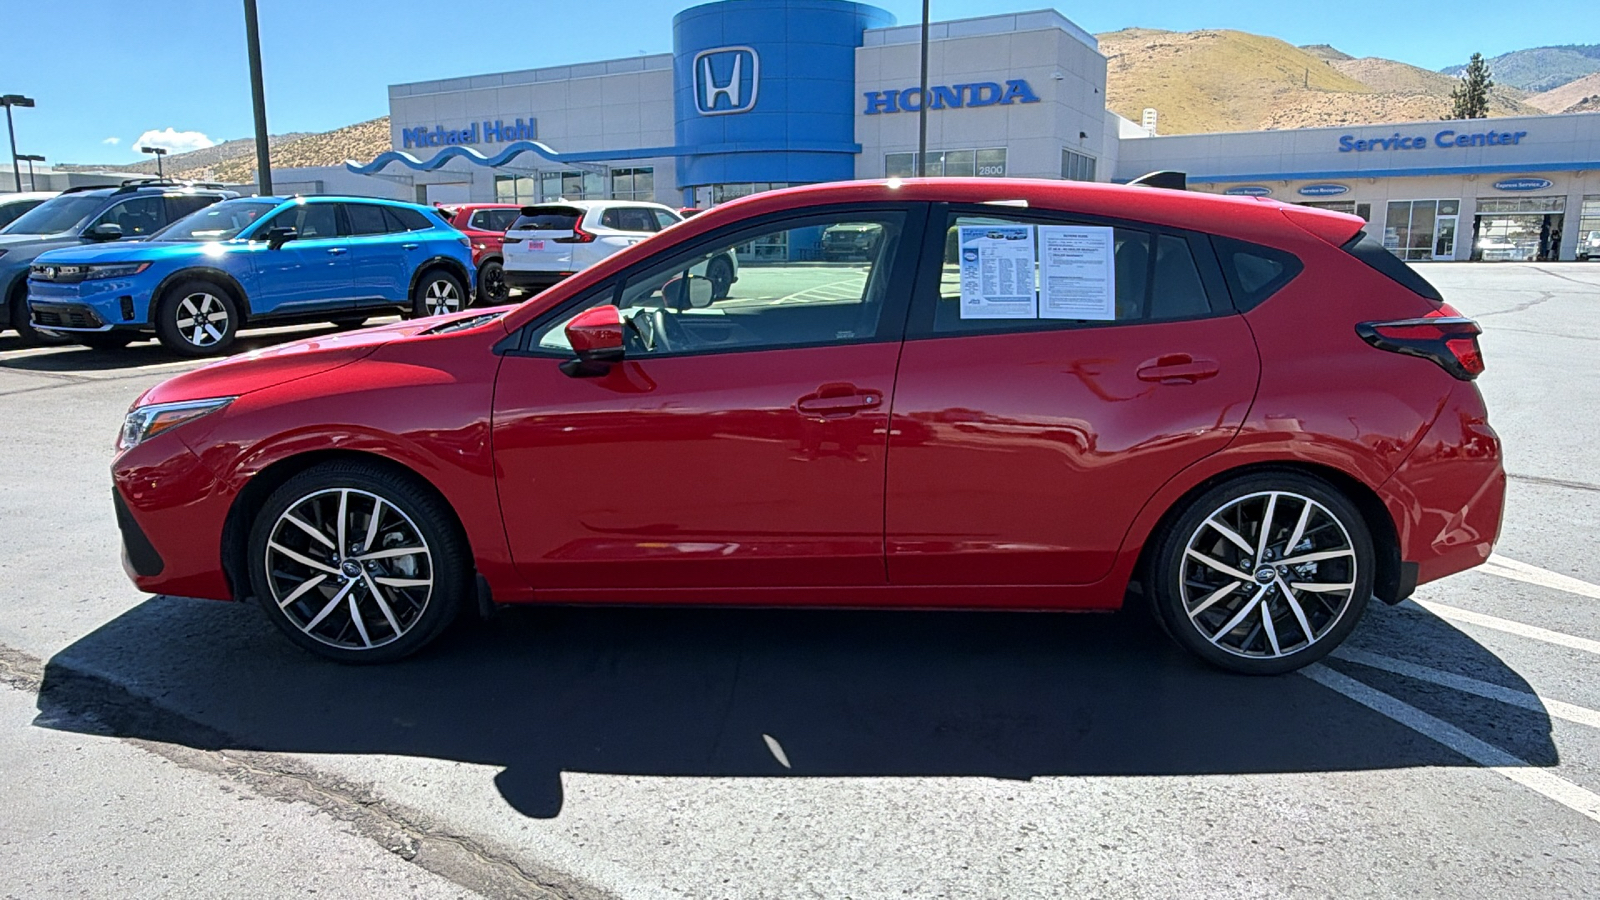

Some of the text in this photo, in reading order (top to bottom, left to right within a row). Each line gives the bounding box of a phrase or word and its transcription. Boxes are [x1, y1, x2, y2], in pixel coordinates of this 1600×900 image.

[863, 79, 1041, 115] HONDA
[402, 117, 537, 149] Michael Hohl
[1338, 130, 1527, 152] Service Center
[979, 165, 1003, 176] 2800
